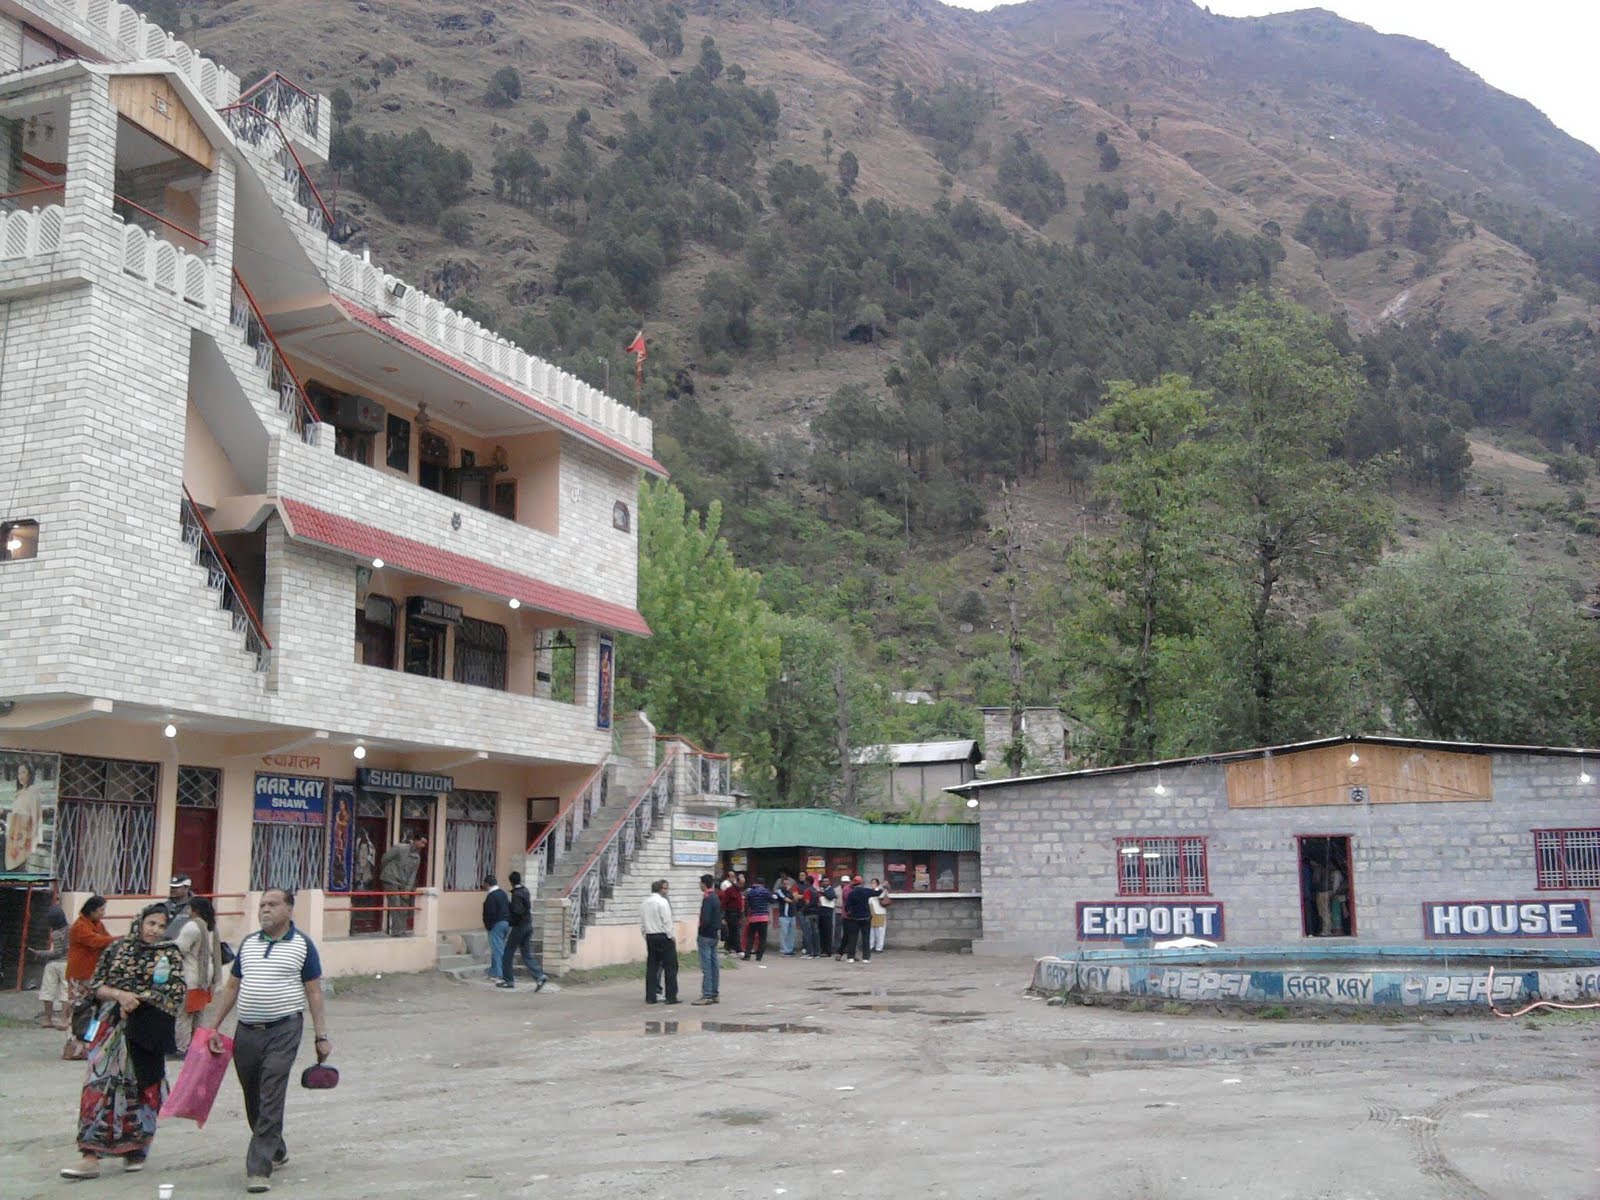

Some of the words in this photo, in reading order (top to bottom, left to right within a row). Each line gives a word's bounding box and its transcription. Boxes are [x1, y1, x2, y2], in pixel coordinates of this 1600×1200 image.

[256, 777, 325, 799] AAR-KAY
[370, 769, 412, 788] SHOW
[413, 774, 453, 792] ROOM
[272, 797, 310, 810] SHAWL
[1083, 907, 1217, 935] EXPORT
[1432, 903, 1578, 934] HOUSE
[1078, 966, 1110, 991] KAY
[1161, 969, 1251, 999] PEPSI
[1287, 975, 1334, 999] AAR
[1336, 977, 1371, 1000] KAY
[1425, 976, 1523, 1001] PEPSI
